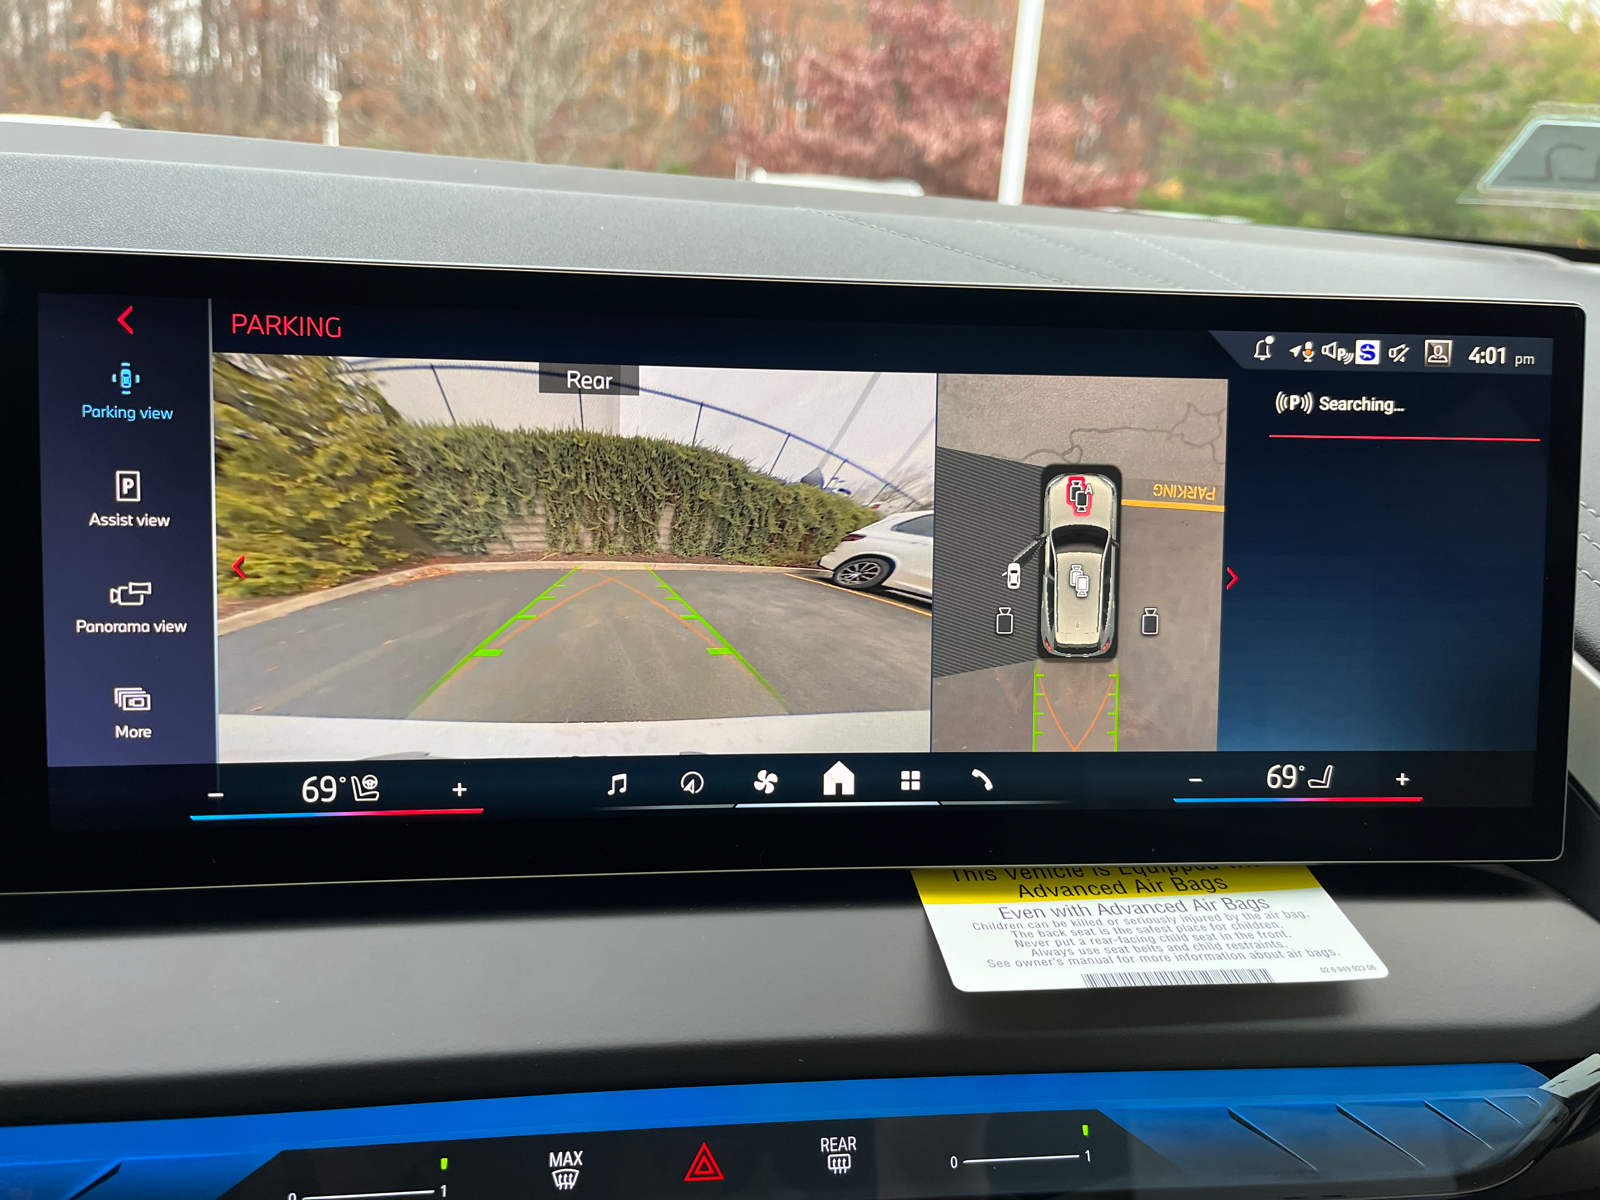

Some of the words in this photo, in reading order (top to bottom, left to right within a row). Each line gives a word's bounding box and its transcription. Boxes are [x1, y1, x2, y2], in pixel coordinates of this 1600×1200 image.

[231, 313, 342, 339] PARKING
[1359, 344, 1376, 361] S
[1468, 346, 1507, 365] 4:01
[1515, 354, 1536, 367] pm
[566, 370, 613, 390] Rear
[82, 404, 136, 422] Parking
[139, 405, 173, 420] view
[122, 478, 134, 495] P
[1153, 483, 1216, 501] PARKING
[89, 512, 134, 527] Assist
[136, 513, 171, 527] view
[76, 620, 150, 634] Panorama
[153, 620, 188, 634] view
[115, 725, 152, 739] More
[1092, 866, 1111, 877] is
[1019, 880, 1128, 898] Advanced
[1135, 879, 1165, 893] Air
[1170, 876, 1228, 893] Bags
[999, 907, 1046, 920] Even
[1049, 904, 1092, 918] with
[1097, 901, 1187, 915] Advanced
[1192, 899, 1218, 912] Air
[1220, 897, 1270, 912] Bags
[972, 922, 1024, 931] Children
[1027, 922, 1049, 930] can
[1052, 919, 1068, 928] be
[1070, 918, 1102, 927] killed
[1124, 915, 1176, 926] seriously
[1180, 914, 1222, 924] injured
[1224, 913, 1240, 923] by
[1242, 911, 1262, 921] the
[1265, 911, 1280, 920] air
[1281, 910, 1310, 920] bag.
[1011, 930, 1034, 939] The
[1038, 929, 1067, 938] back
[1070, 928, 1096, 936] seat
[1099, 927, 1110, 935] is
[1113, 926, 1133, 934] the
[1136, 924, 1172, 934] safest
[1175, 923, 1207, 933] place
[1209, 922, 1228, 931] for
[1231, 921, 1284, 931] children.
[1014, 939, 1050, 948] Never
[1054, 938, 1075, 948] put
[1079, 938, 1086, 946] a
[1090, 935, 1157, 946] rear-facing
[1159, 933, 1189, 943] child
[1193, 933, 1219, 942] seat
[1221, 932, 1235, 941] in
[1236, 931, 1255, 940] the
[1257, 930, 1291, 939] front.
[1031, 948, 1075, 957] Always
[1104, 946, 1130, 954] seat
[1133, 944, 1163, 953] belts
[1166, 943, 1190, 952] and
[1193, 942, 1222, 951] child
[1226, 939, 1288, 950] restraints.
[987, 958, 1011, 968] See
[1015, 957, 1064, 967] owner's
[1068, 955, 1114, 965] manual
[1116, 954, 1134, 963] for
[1139, 953, 1171, 963] more
[1174, 951, 1246, 962] information
[1249, 950, 1285, 960] about
[1287, 949, 1303, 959] air
[1306, 947, 1341, 959] bags.
[820, 1136, 857, 1152] REAR
[549, 1150, 583, 1168] MAX
[950, 1156, 958, 1169] 0
[1085, 1150, 1091, 1162] 1
[440, 1184, 447, 1197] 1
